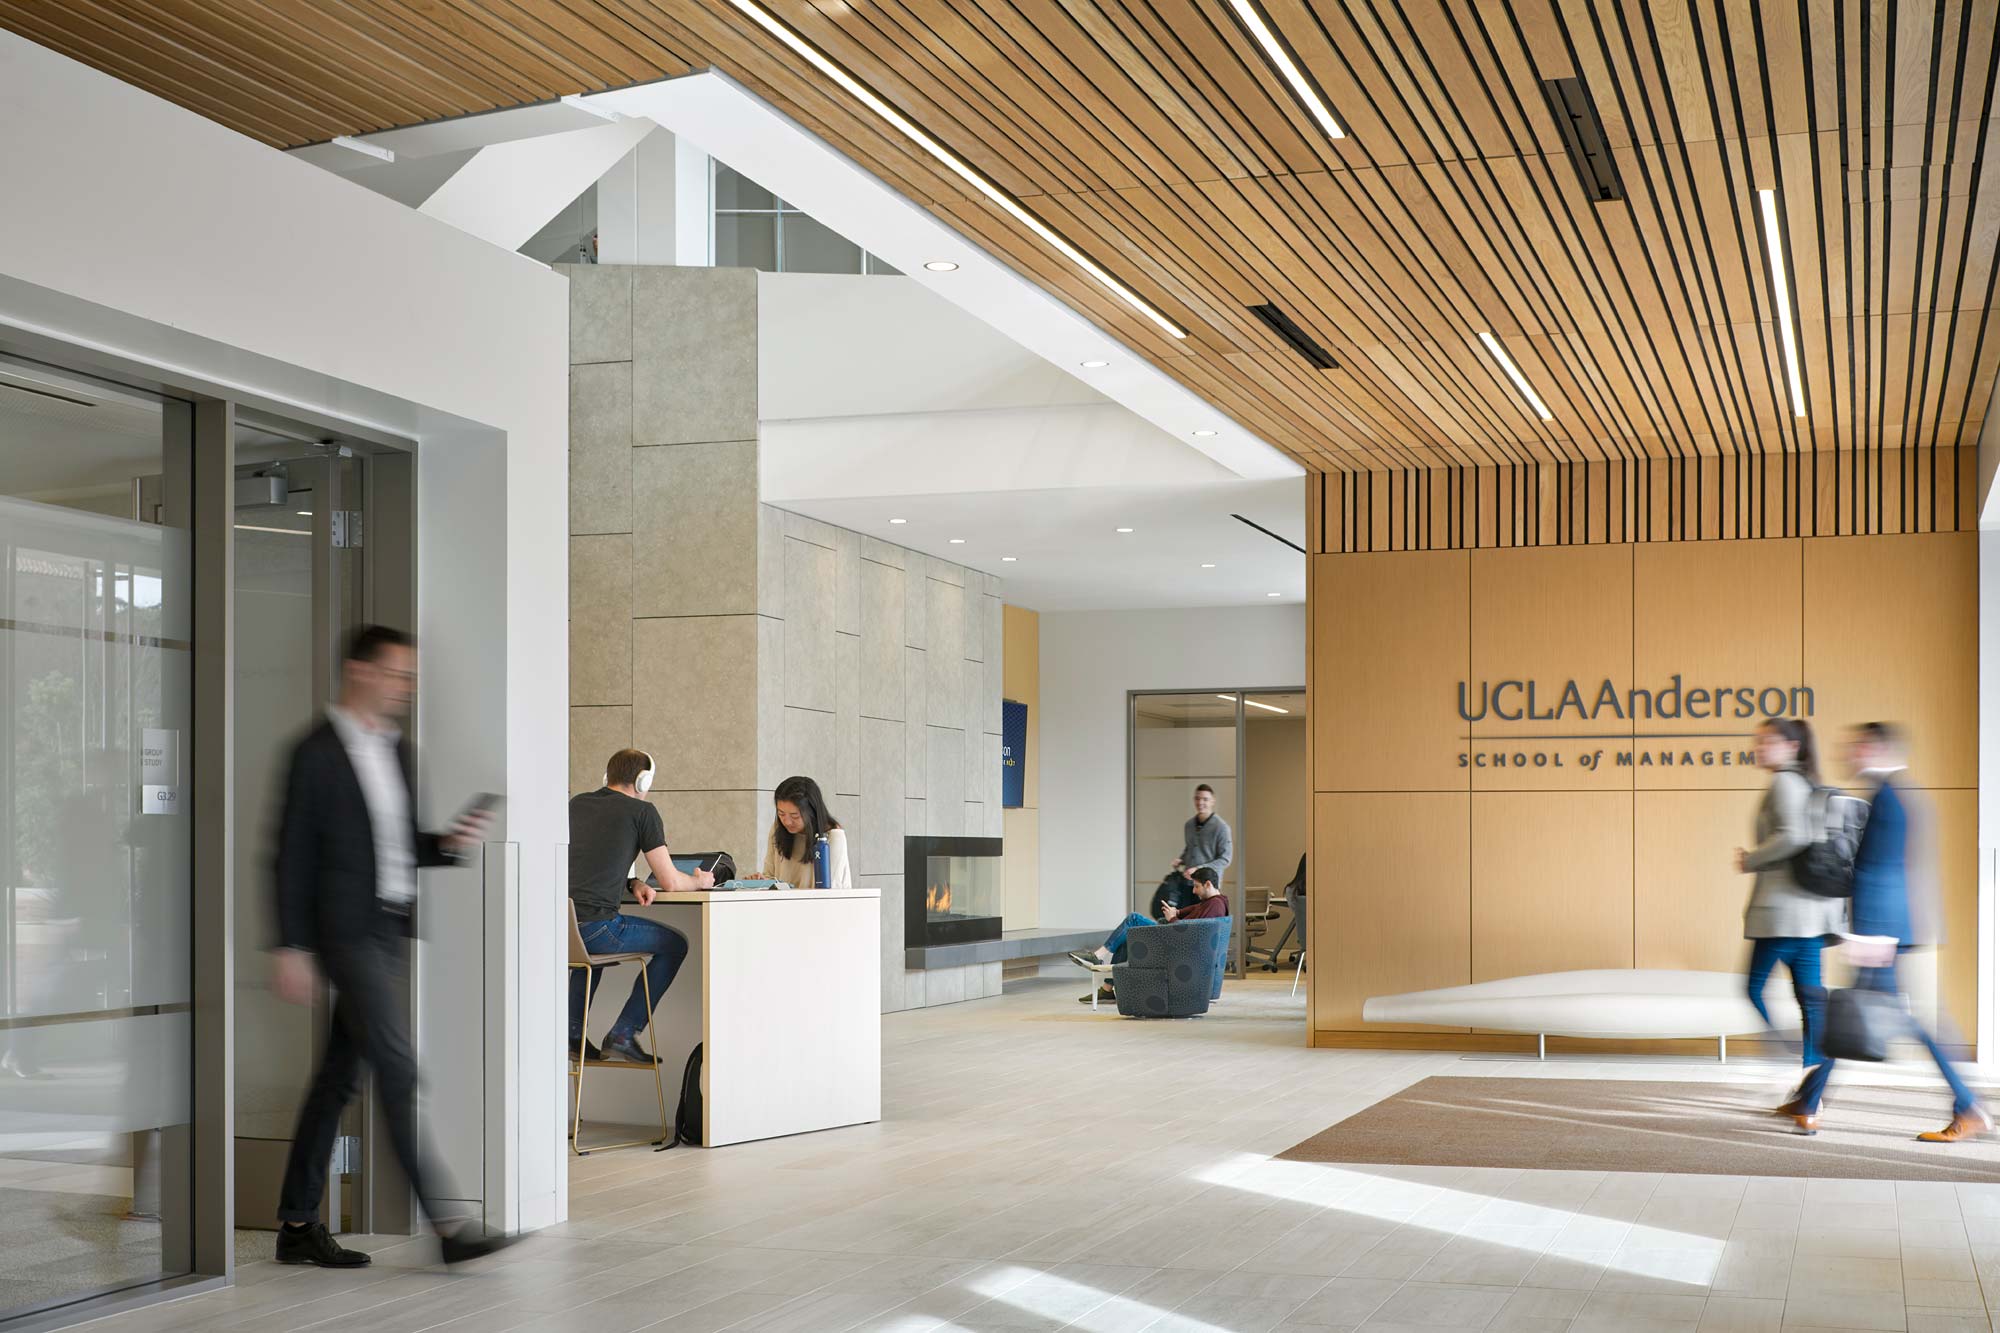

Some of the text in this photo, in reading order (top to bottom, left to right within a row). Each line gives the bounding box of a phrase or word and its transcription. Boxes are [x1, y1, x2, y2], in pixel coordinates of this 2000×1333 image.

[1458, 750, 1757, 771] SCHOOL of MANAGEM
